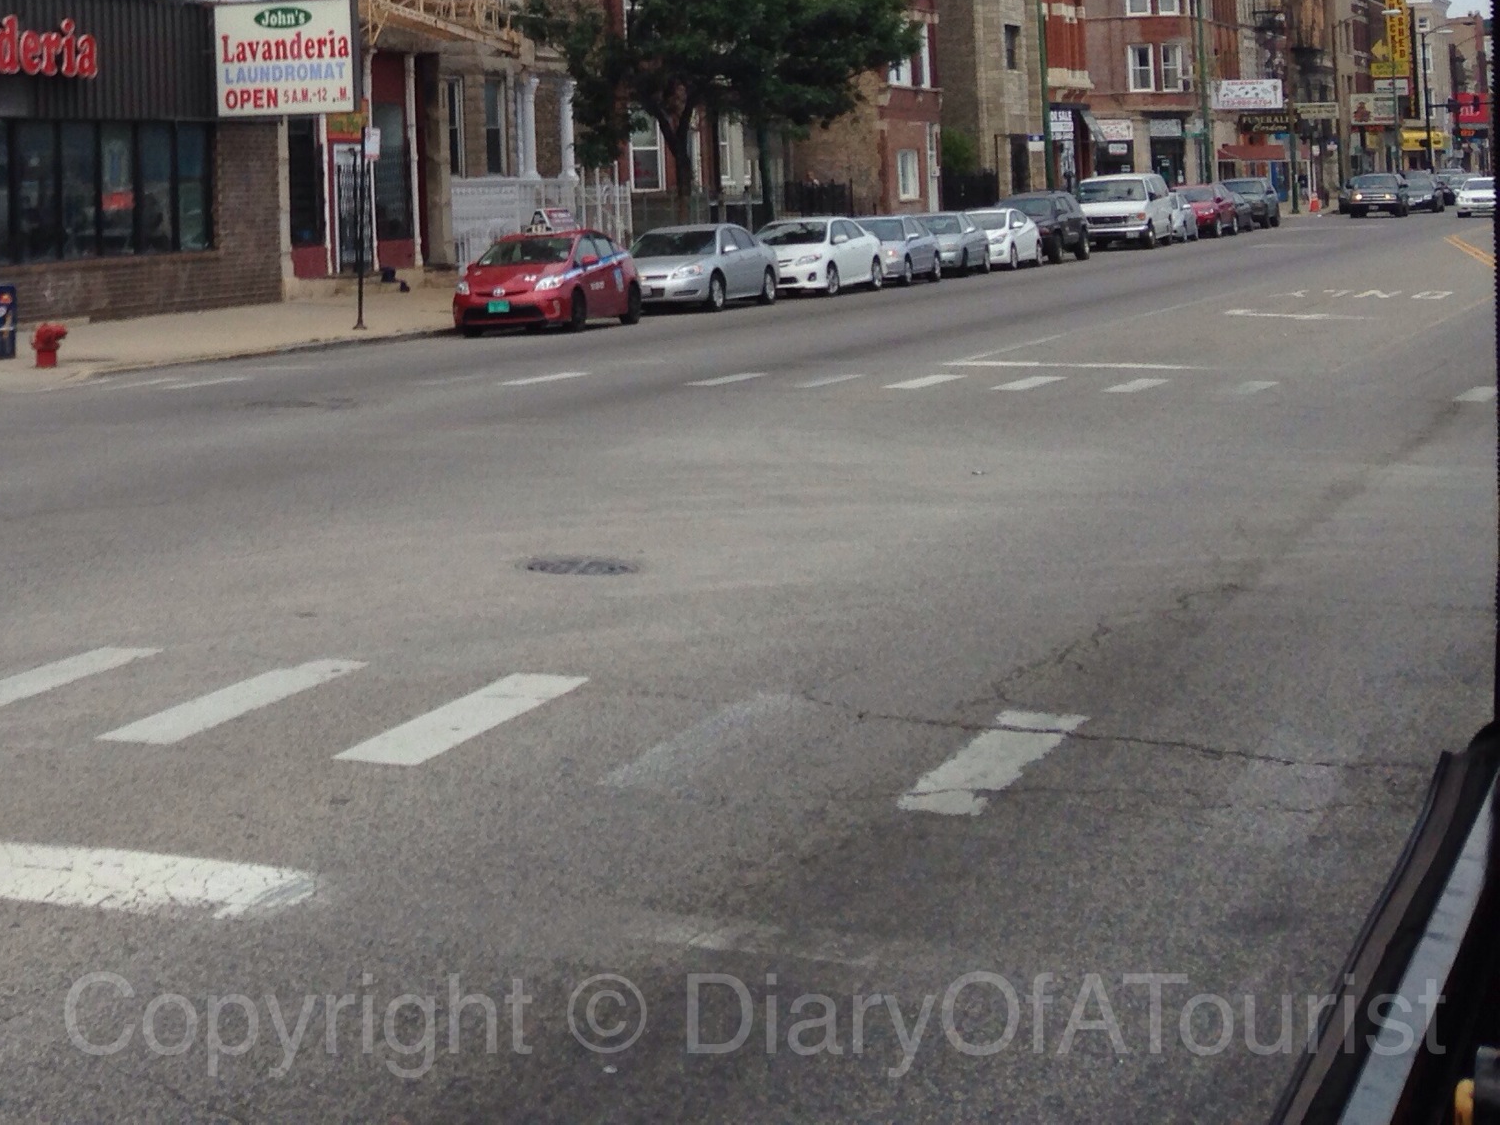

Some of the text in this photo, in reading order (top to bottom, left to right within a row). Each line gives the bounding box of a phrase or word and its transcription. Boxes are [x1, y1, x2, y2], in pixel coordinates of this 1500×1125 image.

[261, 9, 306, 26] John's
[221, 29, 349, 63] Lavanderia
[224, 61, 346, 85] LAUNDROMAT
[225, 87, 279, 109] OPEN
[1058, 110, 1072, 121] SALE
